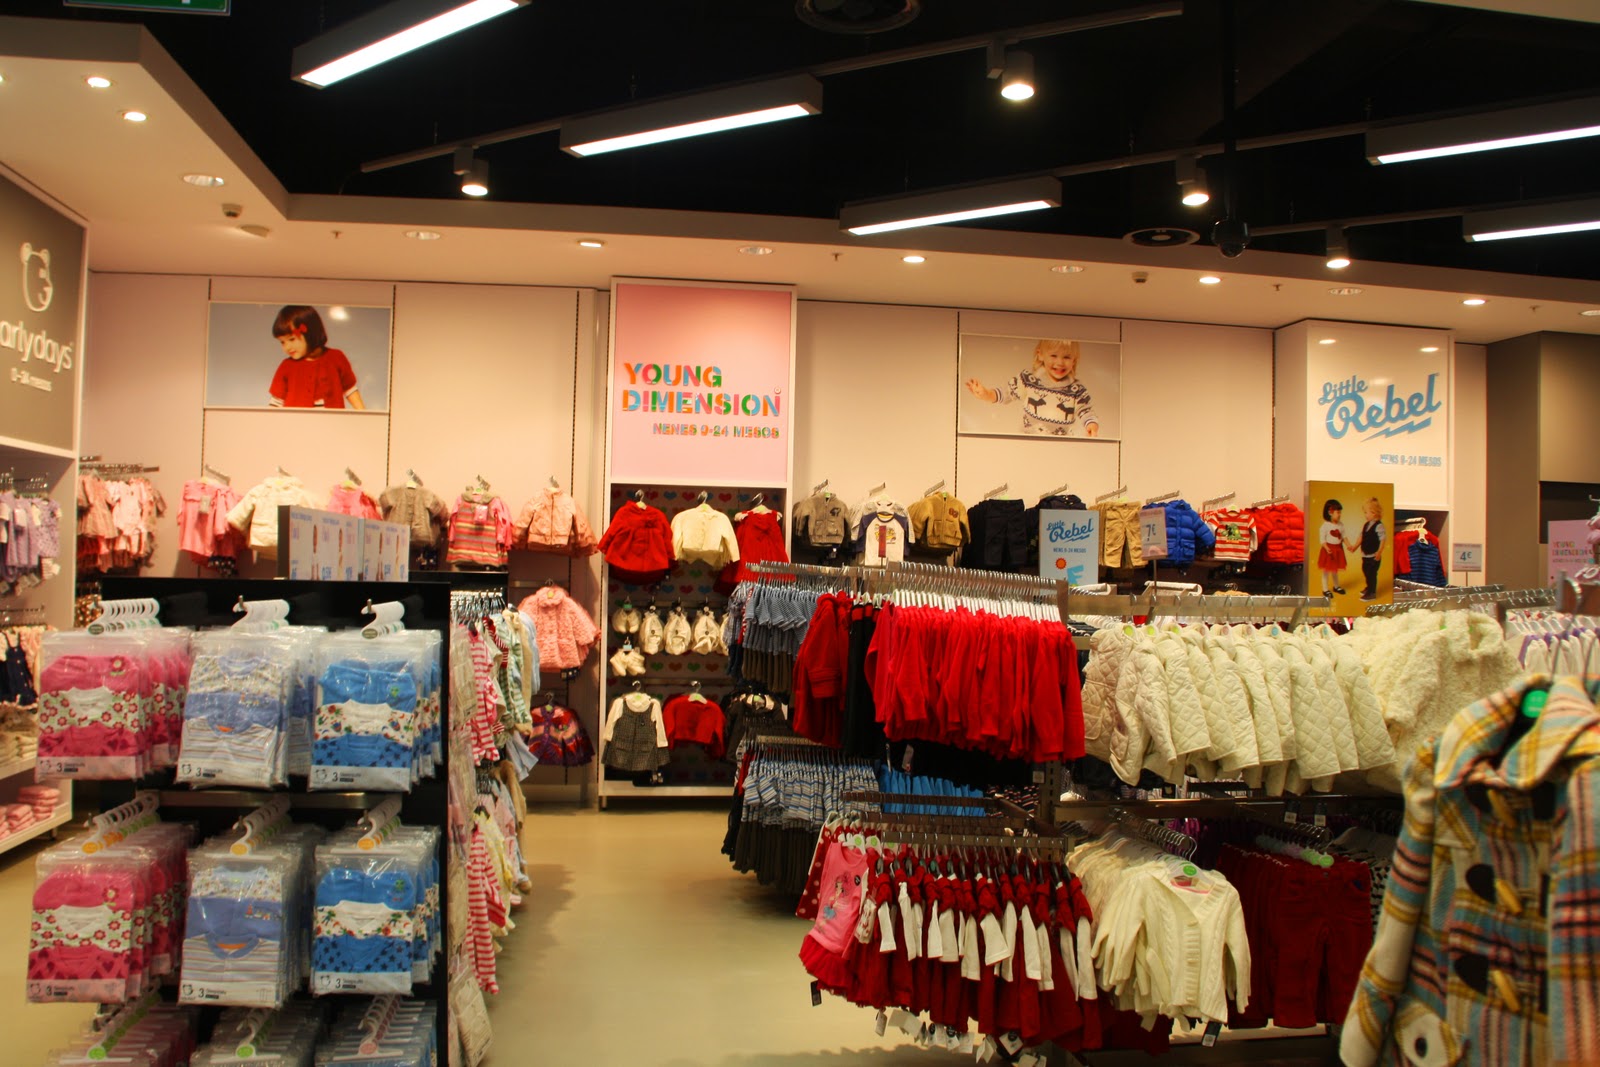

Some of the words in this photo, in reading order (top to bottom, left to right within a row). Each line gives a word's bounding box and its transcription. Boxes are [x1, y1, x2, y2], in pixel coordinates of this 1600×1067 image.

[0, 320, 72, 373] arlydays
[623, 362, 722, 388] YOUNG
[1318, 374, 1369, 405] Little
[622, 389, 781, 417] DIMENSION
[1325, 373, 1442, 440] Rebel
[652, 422, 698, 436] NENES
[733, 425, 780, 439] MESOS
[1418, 455, 1442, 467] MESOS
[1046, 520, 1065, 531] Little
[1049, 518, 1094, 543] Rebel
[56, 762, 63, 773] 3
[195, 767, 202, 777] 3
[331, 771, 339, 782] 3
[335, 978, 341, 989] 3
[46, 986, 52, 996] 3
[198, 987, 205, 999] 3
